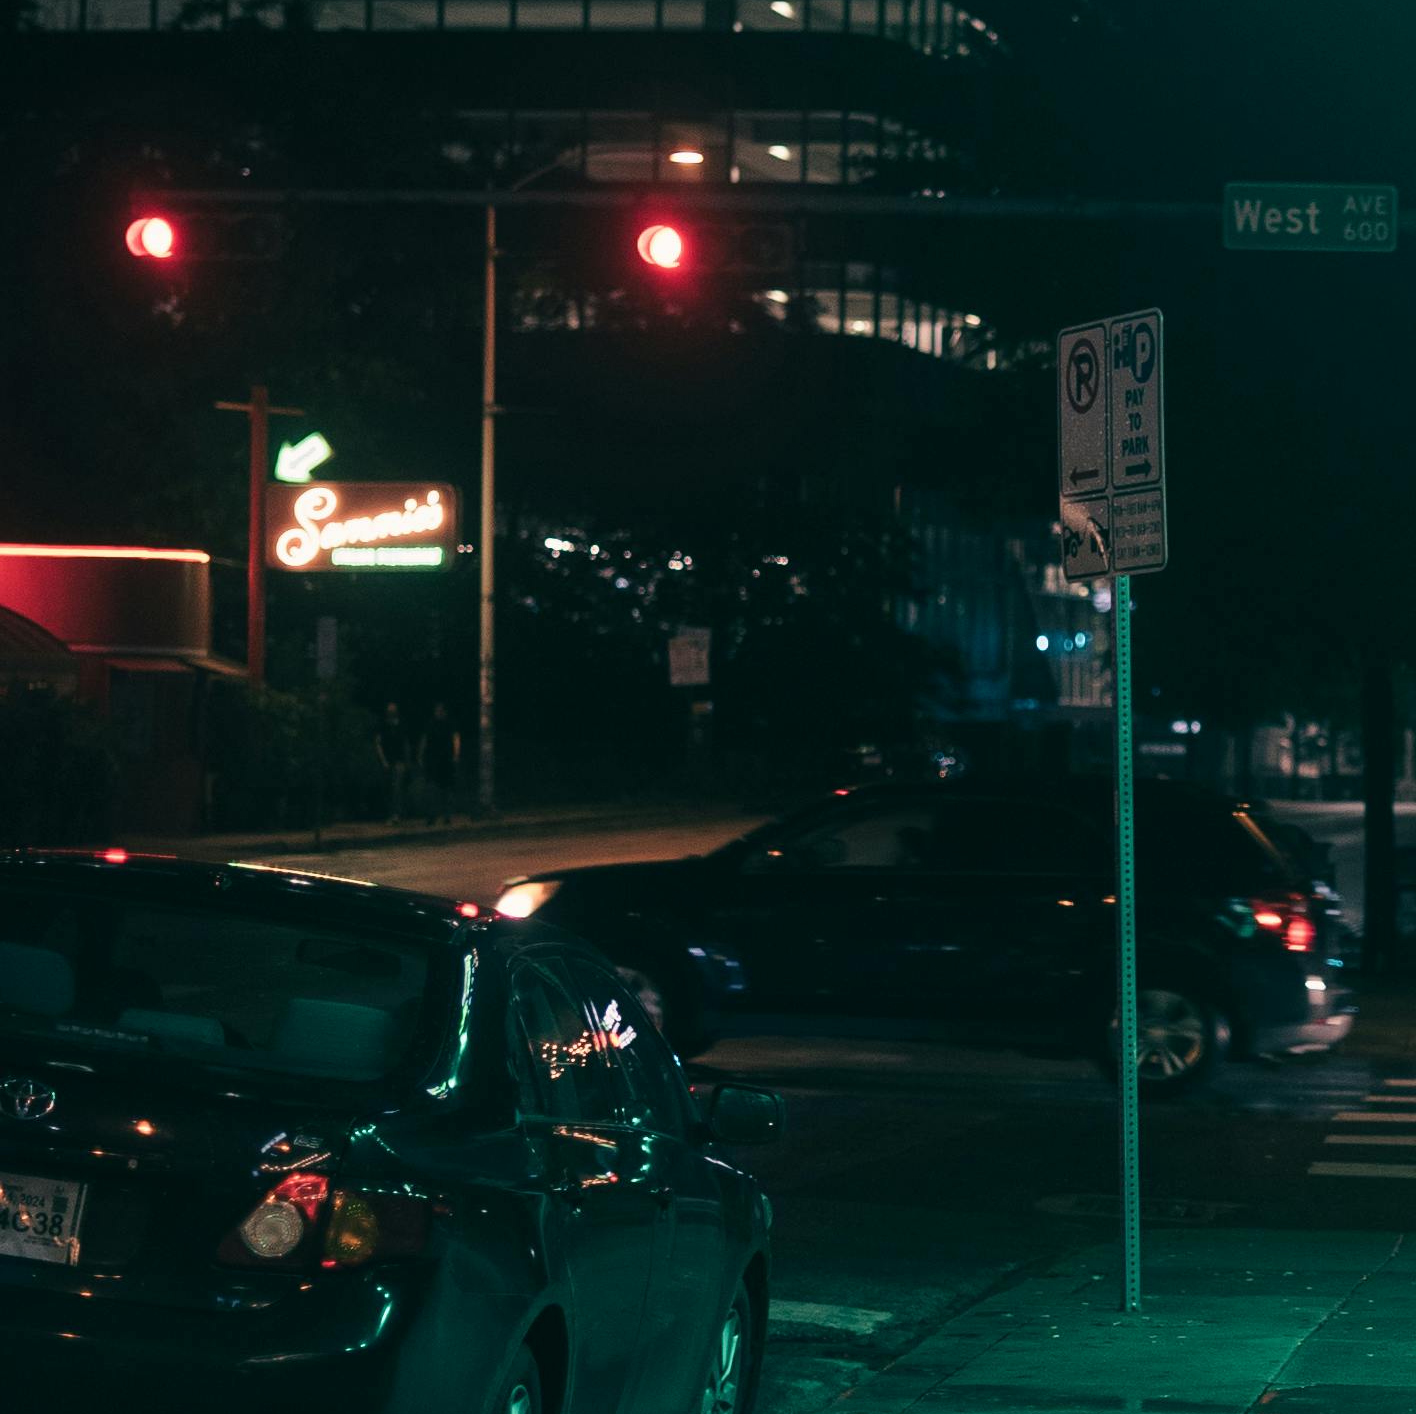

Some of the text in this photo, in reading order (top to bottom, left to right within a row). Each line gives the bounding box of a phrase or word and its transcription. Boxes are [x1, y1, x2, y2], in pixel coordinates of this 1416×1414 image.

[1233, 195, 1388, 235] West AVE
[1343, 221, 1390, 241] 600
[1125, 388, 1145, 408] PAY
[1128, 412, 1142, 432] TO
[1121, 435, 1150, 457] PARK
